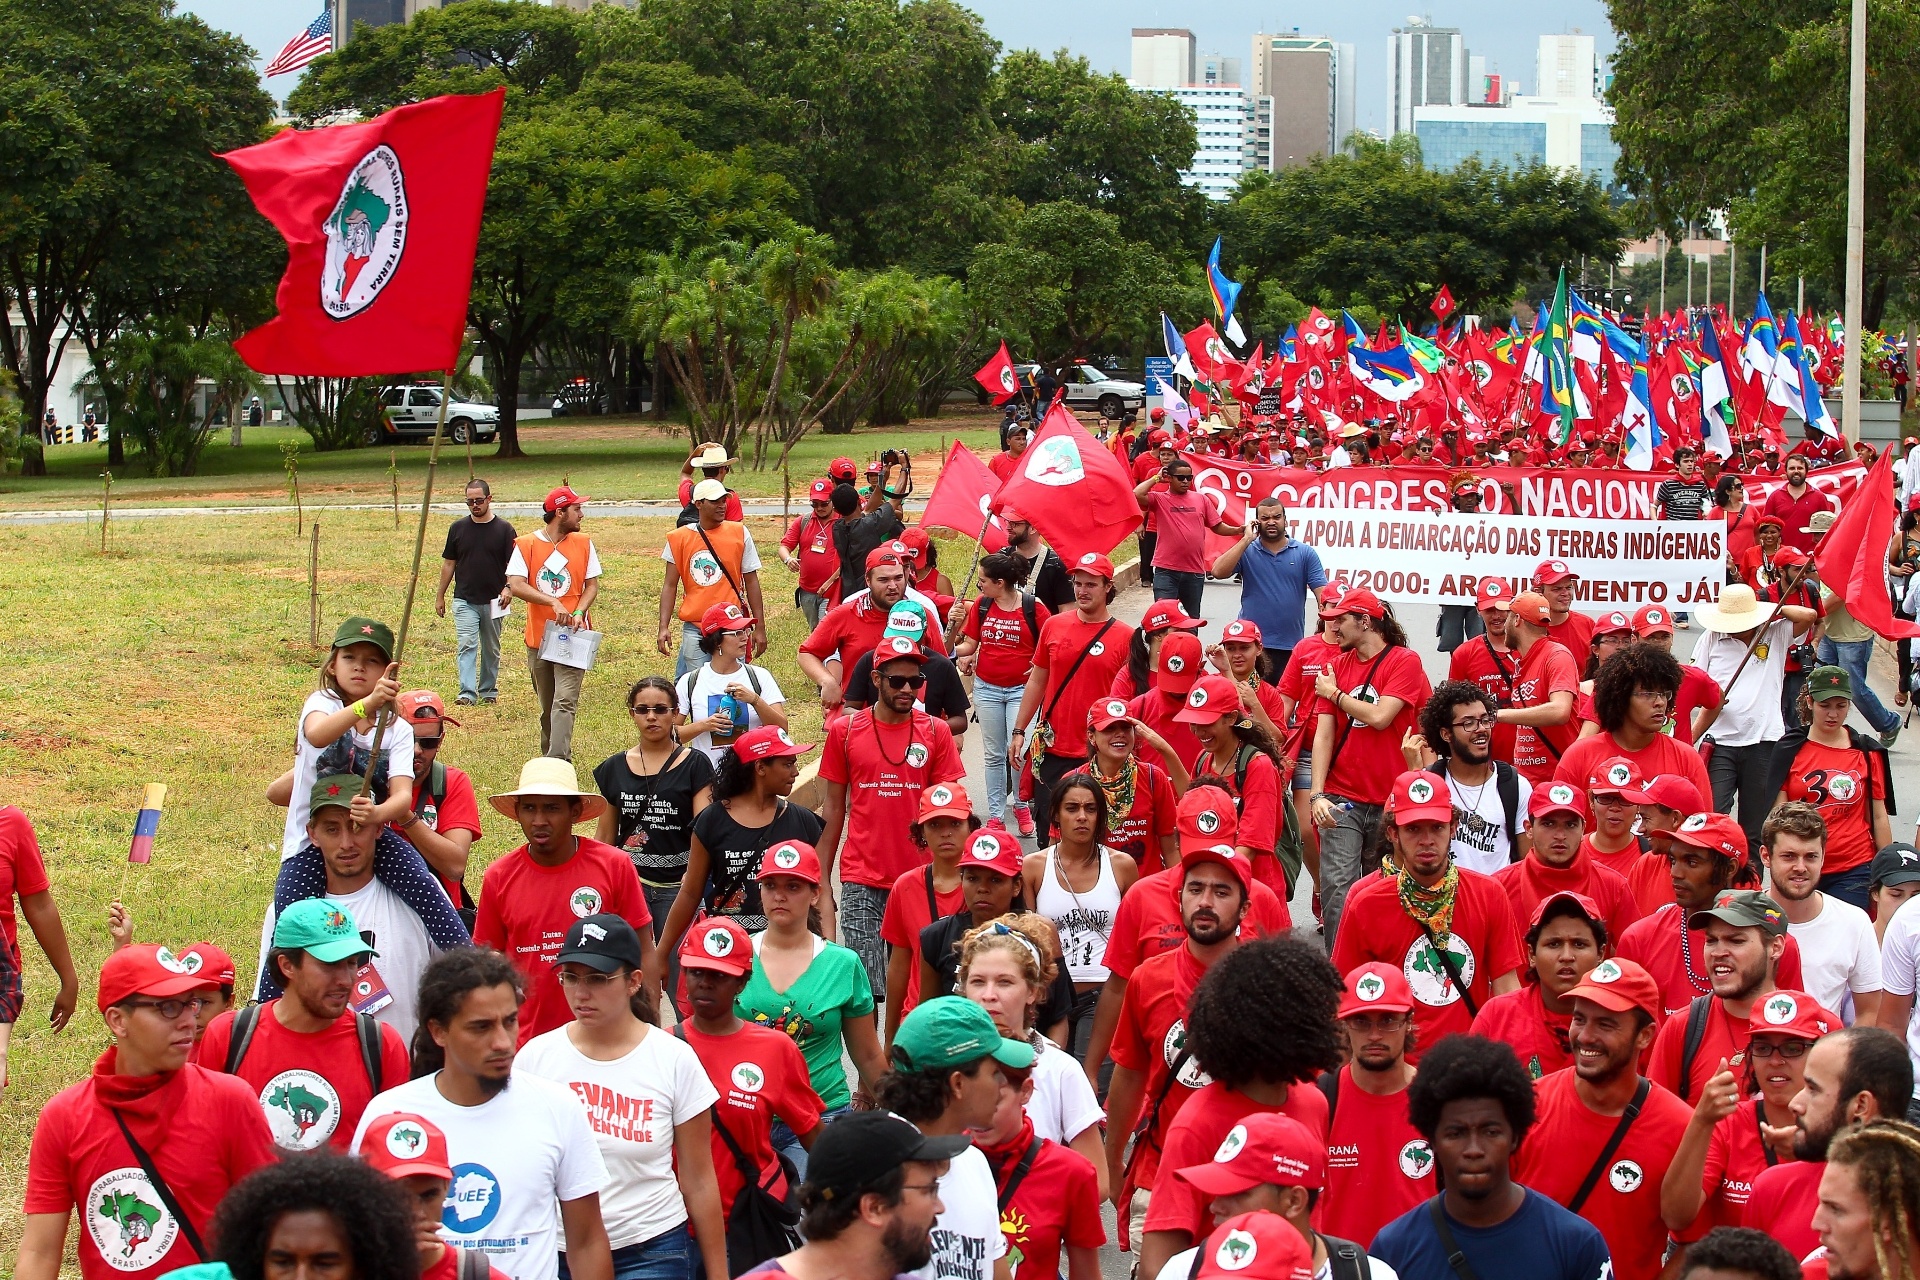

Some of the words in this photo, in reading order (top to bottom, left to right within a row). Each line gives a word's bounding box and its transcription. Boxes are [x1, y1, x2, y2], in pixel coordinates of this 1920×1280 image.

[392, 221, 403, 249] SEM
[369, 253, 397, 290] TERRA
[1270, 479, 1502, 514] CONGRESO
[1303, 519, 1354, 548] APOIA
[1359, 521, 1372, 549] A
[1377, 520, 1500, 561] DEMARCAÇÃO
[1506, 527, 1541, 556] DAS
[1547, 529, 1618, 560] TERRAS
[1623, 526, 1721, 561] INDÍGENAS
[1677, 576, 1720, 603] JÁ!
[620, 791, 634, 801] Faz
[651, 799, 672, 808] canto
[725, 850, 740, 859] Faz
[730, 858, 748, 866] mas
[569, 1082, 653, 1121] EVANTE
[1328, 1143, 1359, 1155] RANÁ
[1722, 1178, 1752, 1191] PARA
[458, 1188, 487, 1202] UEE
[88, 1208, 106, 1250] MOVIMENTO
[155, 1230, 174, 1254] TERRA
[477, 1237, 516, 1248] ESTUDANTES
[112, 1256, 144, 1268] BRASIL
